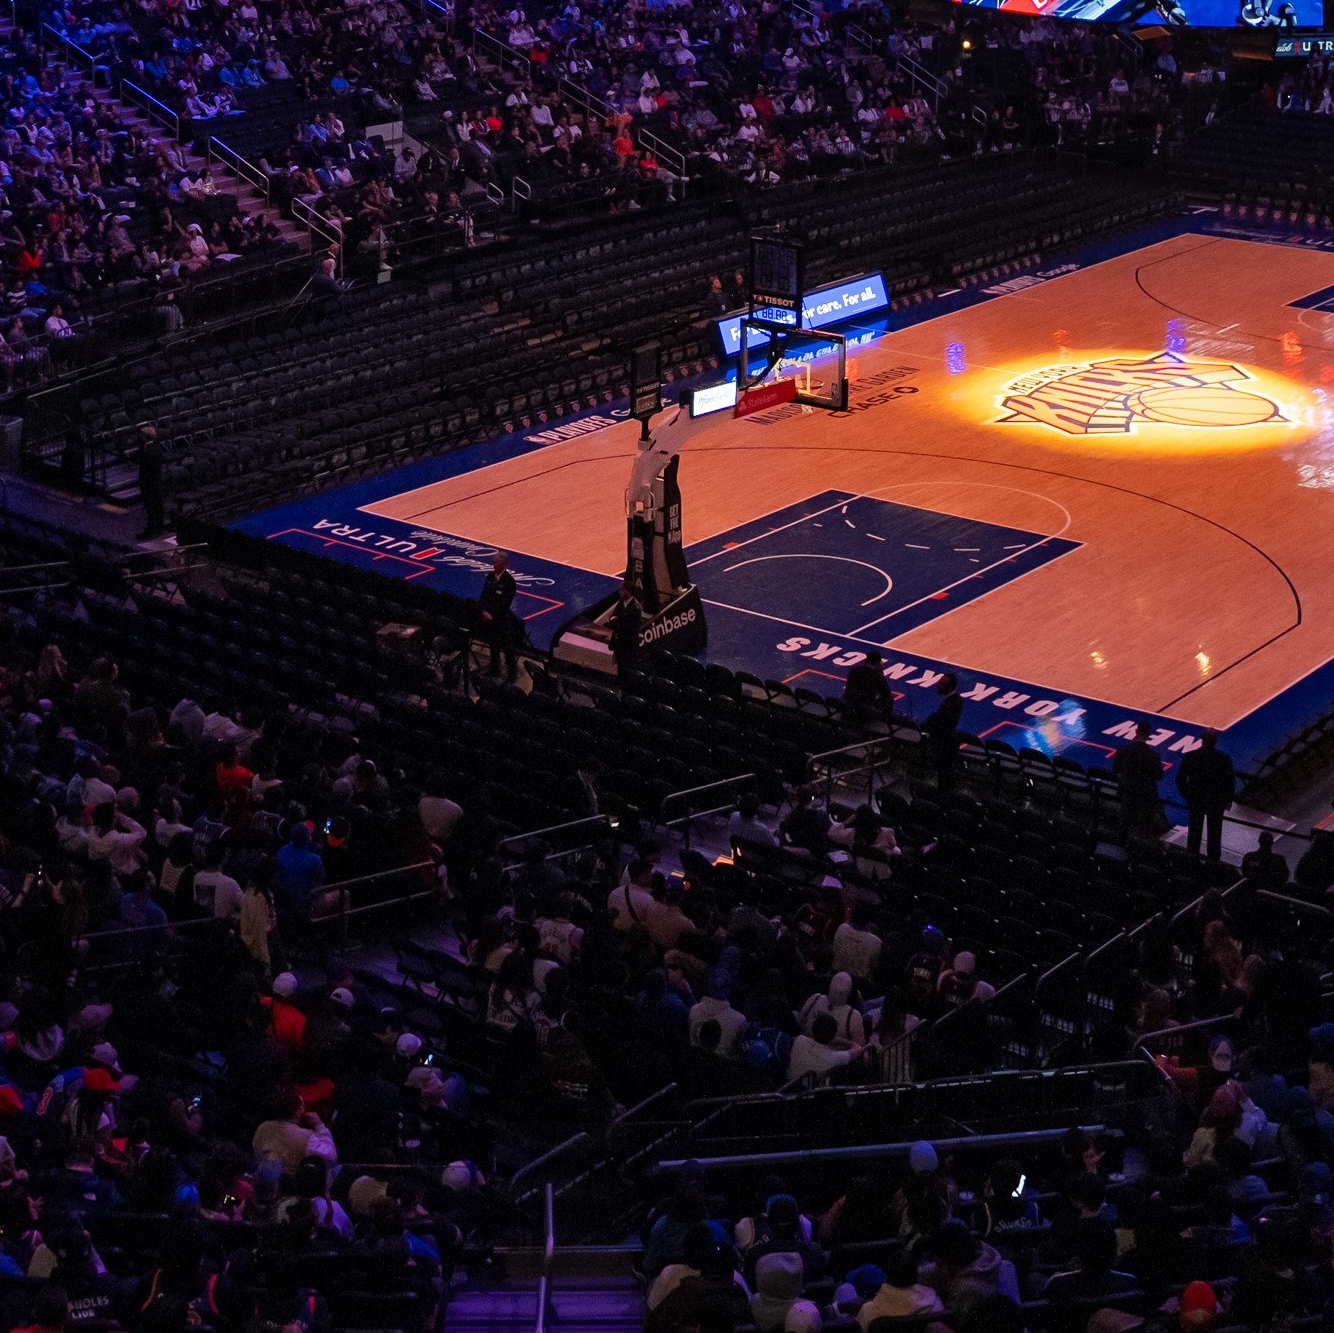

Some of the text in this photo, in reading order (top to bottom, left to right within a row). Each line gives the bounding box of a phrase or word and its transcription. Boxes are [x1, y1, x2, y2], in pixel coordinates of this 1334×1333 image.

[764, 296, 794, 307] TISSOT
[842, 287, 876, 307] For all.
[1003, 361, 1234, 435] KNICKS
[539, 415, 617, 441] PLAYOFFS
[313, 518, 417, 553] ULTRA
[960, 683, 1087, 726] YORK
